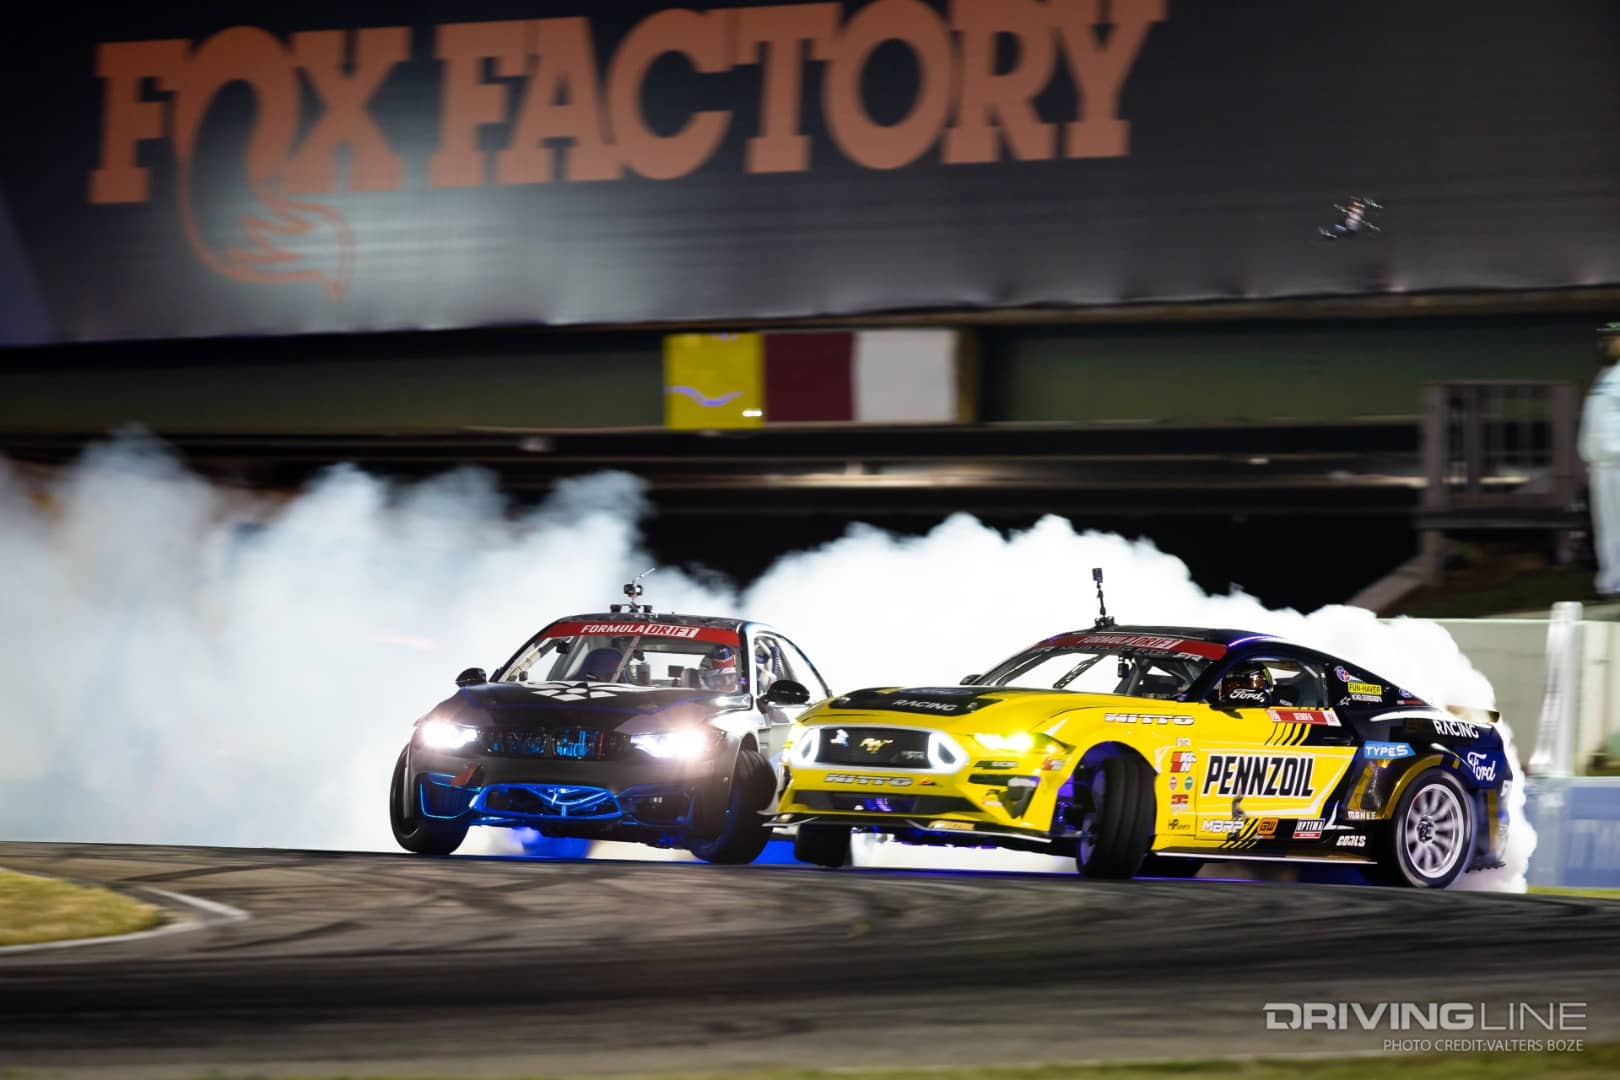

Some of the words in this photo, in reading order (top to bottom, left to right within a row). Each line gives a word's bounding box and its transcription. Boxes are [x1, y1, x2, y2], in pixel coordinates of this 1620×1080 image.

[90, 25, 412, 300] FOX
[430, 0, 1167, 187] FACTORY
[580, 624, 645, 633] FORMULA
[644, 624, 699, 637] DRIFT
[1229, 688, 1265, 702] Ford
[893, 699, 958, 711] RACING
[1433, 720, 1479, 739] RACING
[1467, 752, 1496, 782] Ford
[824, 774, 913, 787] NITTO
[1202, 754, 1315, 798] PENNZOIL
